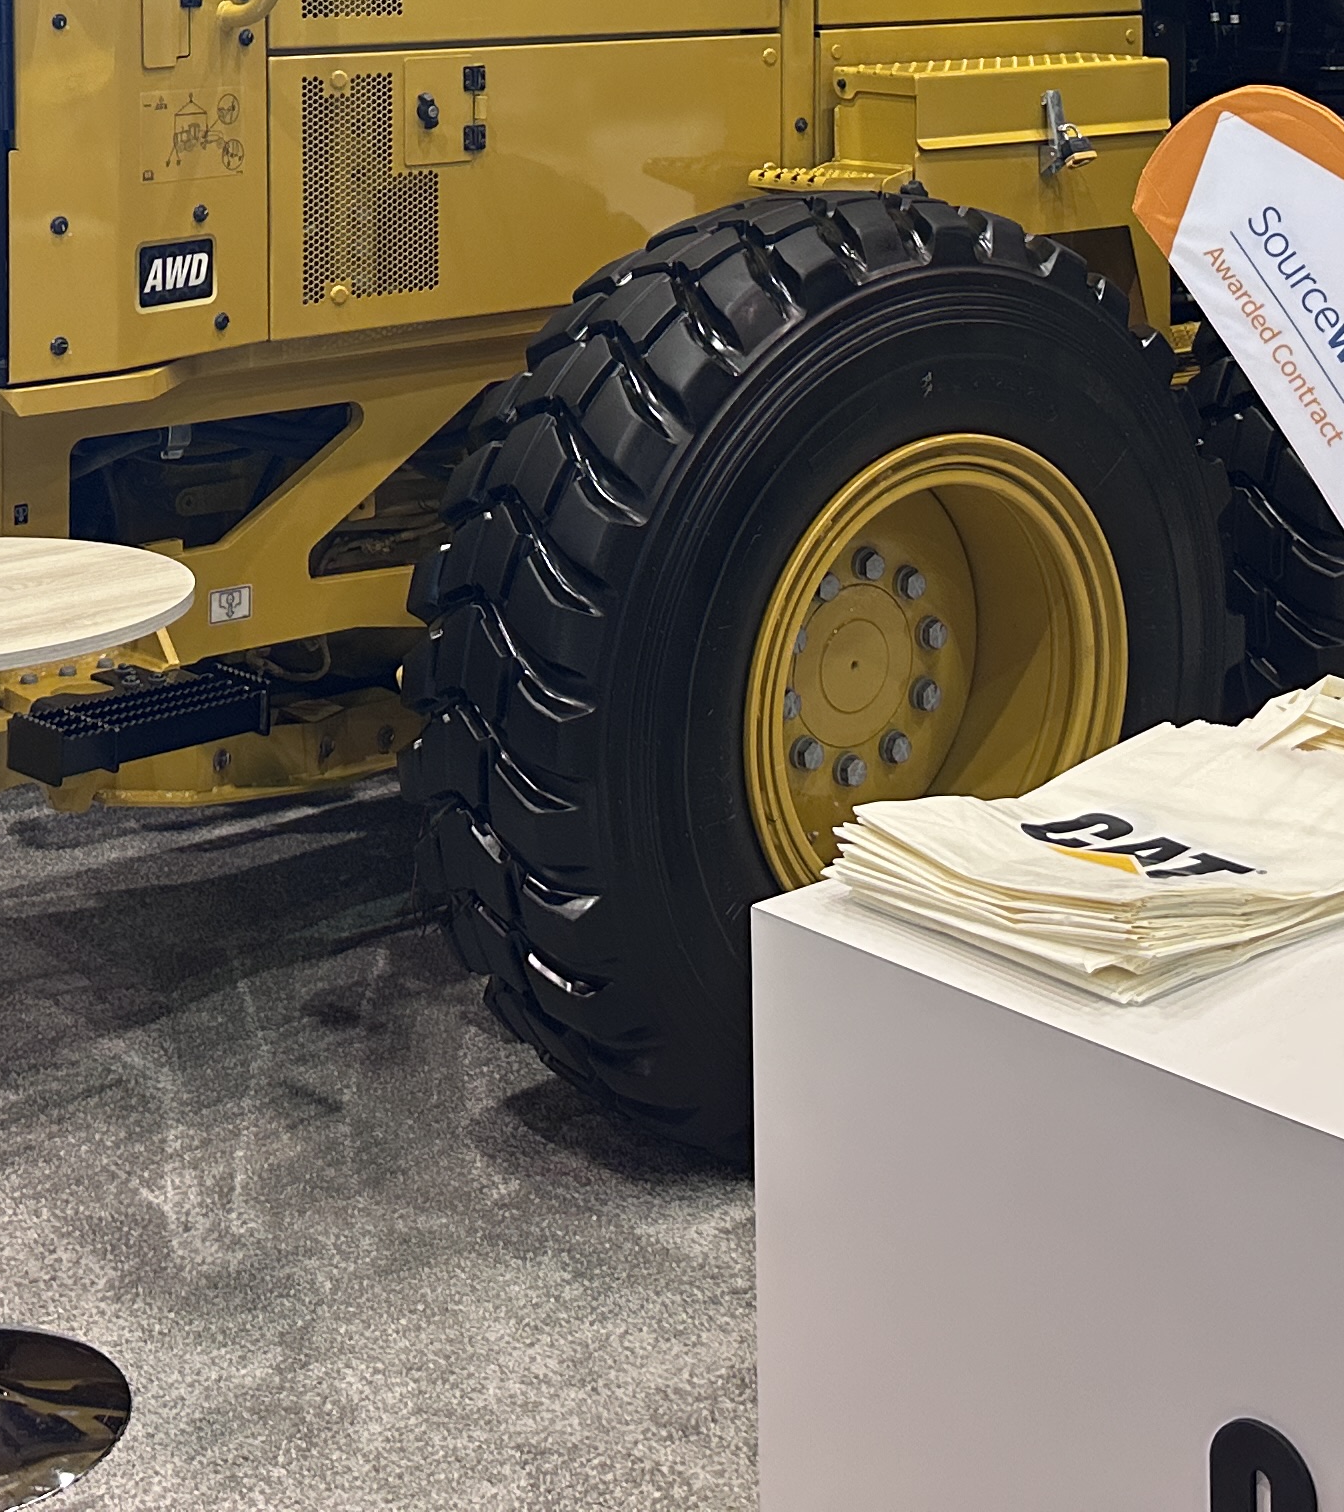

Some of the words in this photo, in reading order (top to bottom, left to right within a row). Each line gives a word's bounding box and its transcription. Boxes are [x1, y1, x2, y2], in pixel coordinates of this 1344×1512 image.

[143, 252, 209, 294] AWD
[1203, 246, 1280, 345] Awarded
[1272, 344, 1344, 448] Contract
[1021, 812, 1256, 878] CAT
